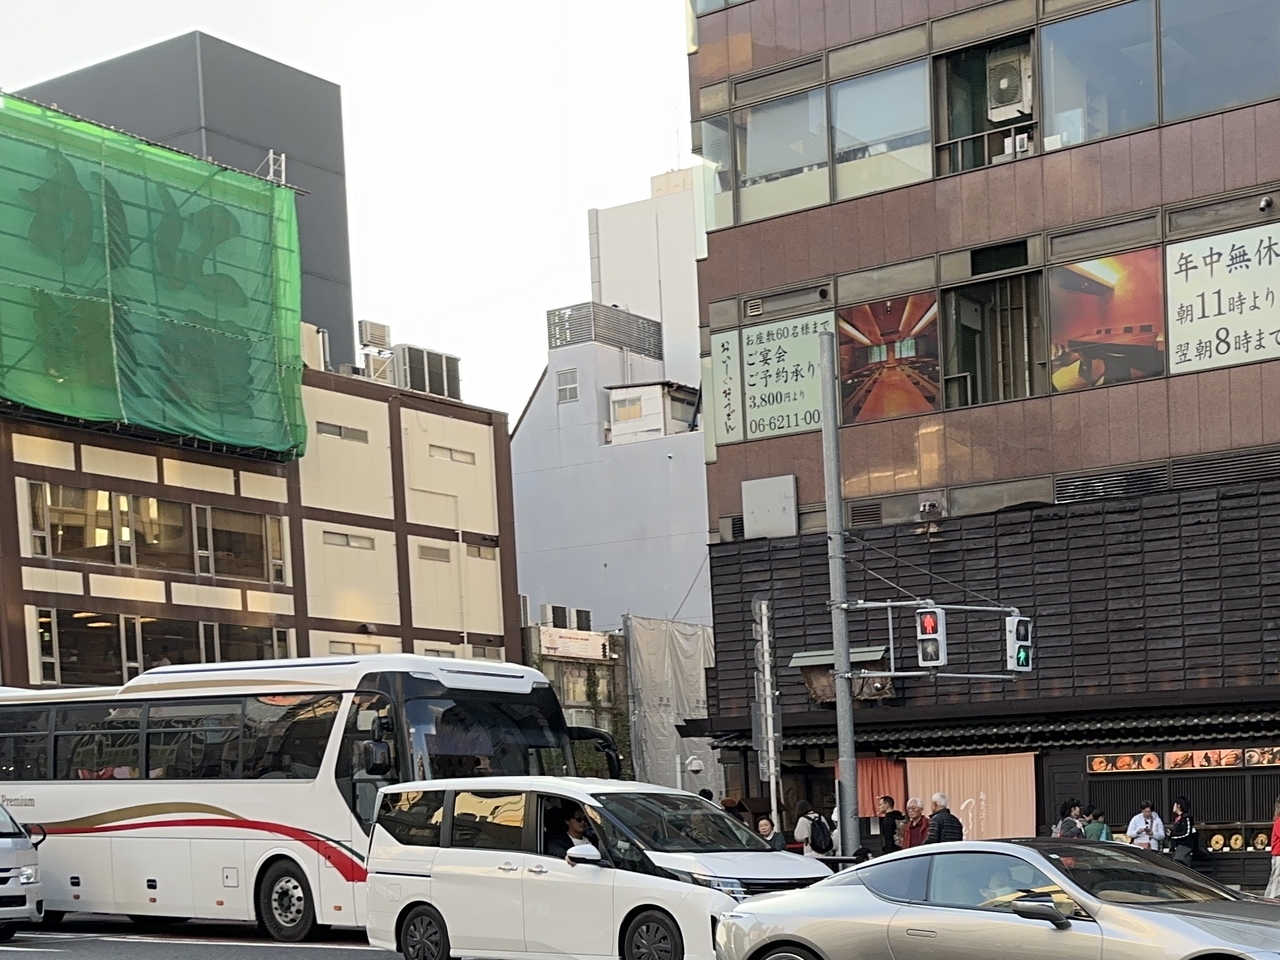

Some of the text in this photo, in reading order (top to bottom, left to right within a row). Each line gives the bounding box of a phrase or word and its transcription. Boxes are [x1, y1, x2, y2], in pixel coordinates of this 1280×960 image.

[1176, 287, 1275, 325] 朝11時より
[746, 320, 830, 347] お座敷60名様まで
[746, 345, 788, 367] ご宴会
[747, 361, 821, 388] ご予約承り
[749, 390, 805, 409] 3,800円より
[750, 409, 823, 433] 06-6211-00
